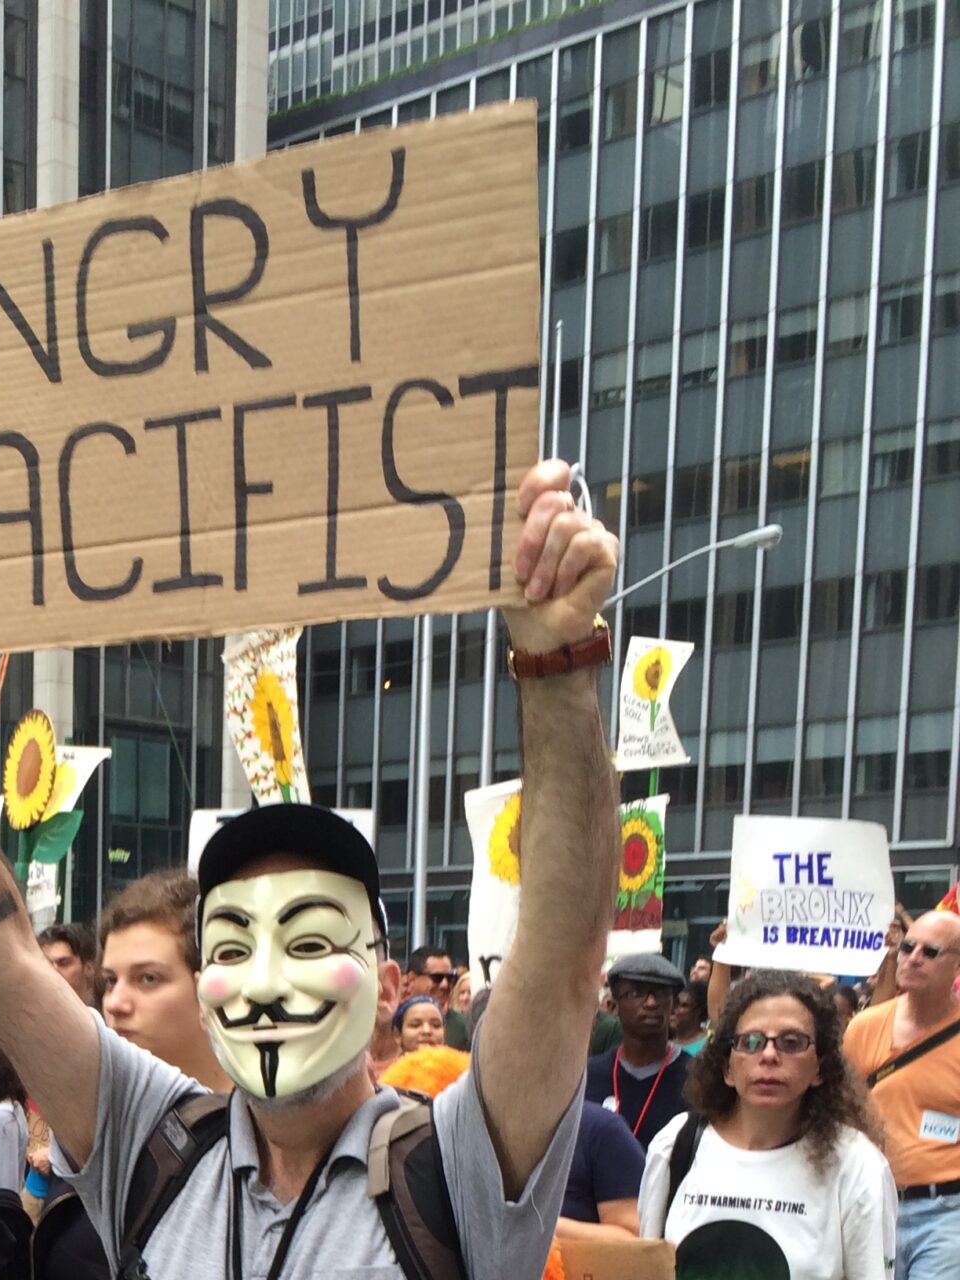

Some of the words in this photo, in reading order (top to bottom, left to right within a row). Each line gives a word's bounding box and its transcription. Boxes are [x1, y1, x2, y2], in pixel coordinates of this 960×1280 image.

[773, 853, 834, 886] THE
[760, 888, 874, 927] BRONX
[763, 926, 779, 944] IS
[786, 926, 884, 951] BREATHING
[710, 1195, 751, 1210] WARMING
[753, 1199, 773, 1211] IT'S
[775, 1200, 808, 1216] DYING.
